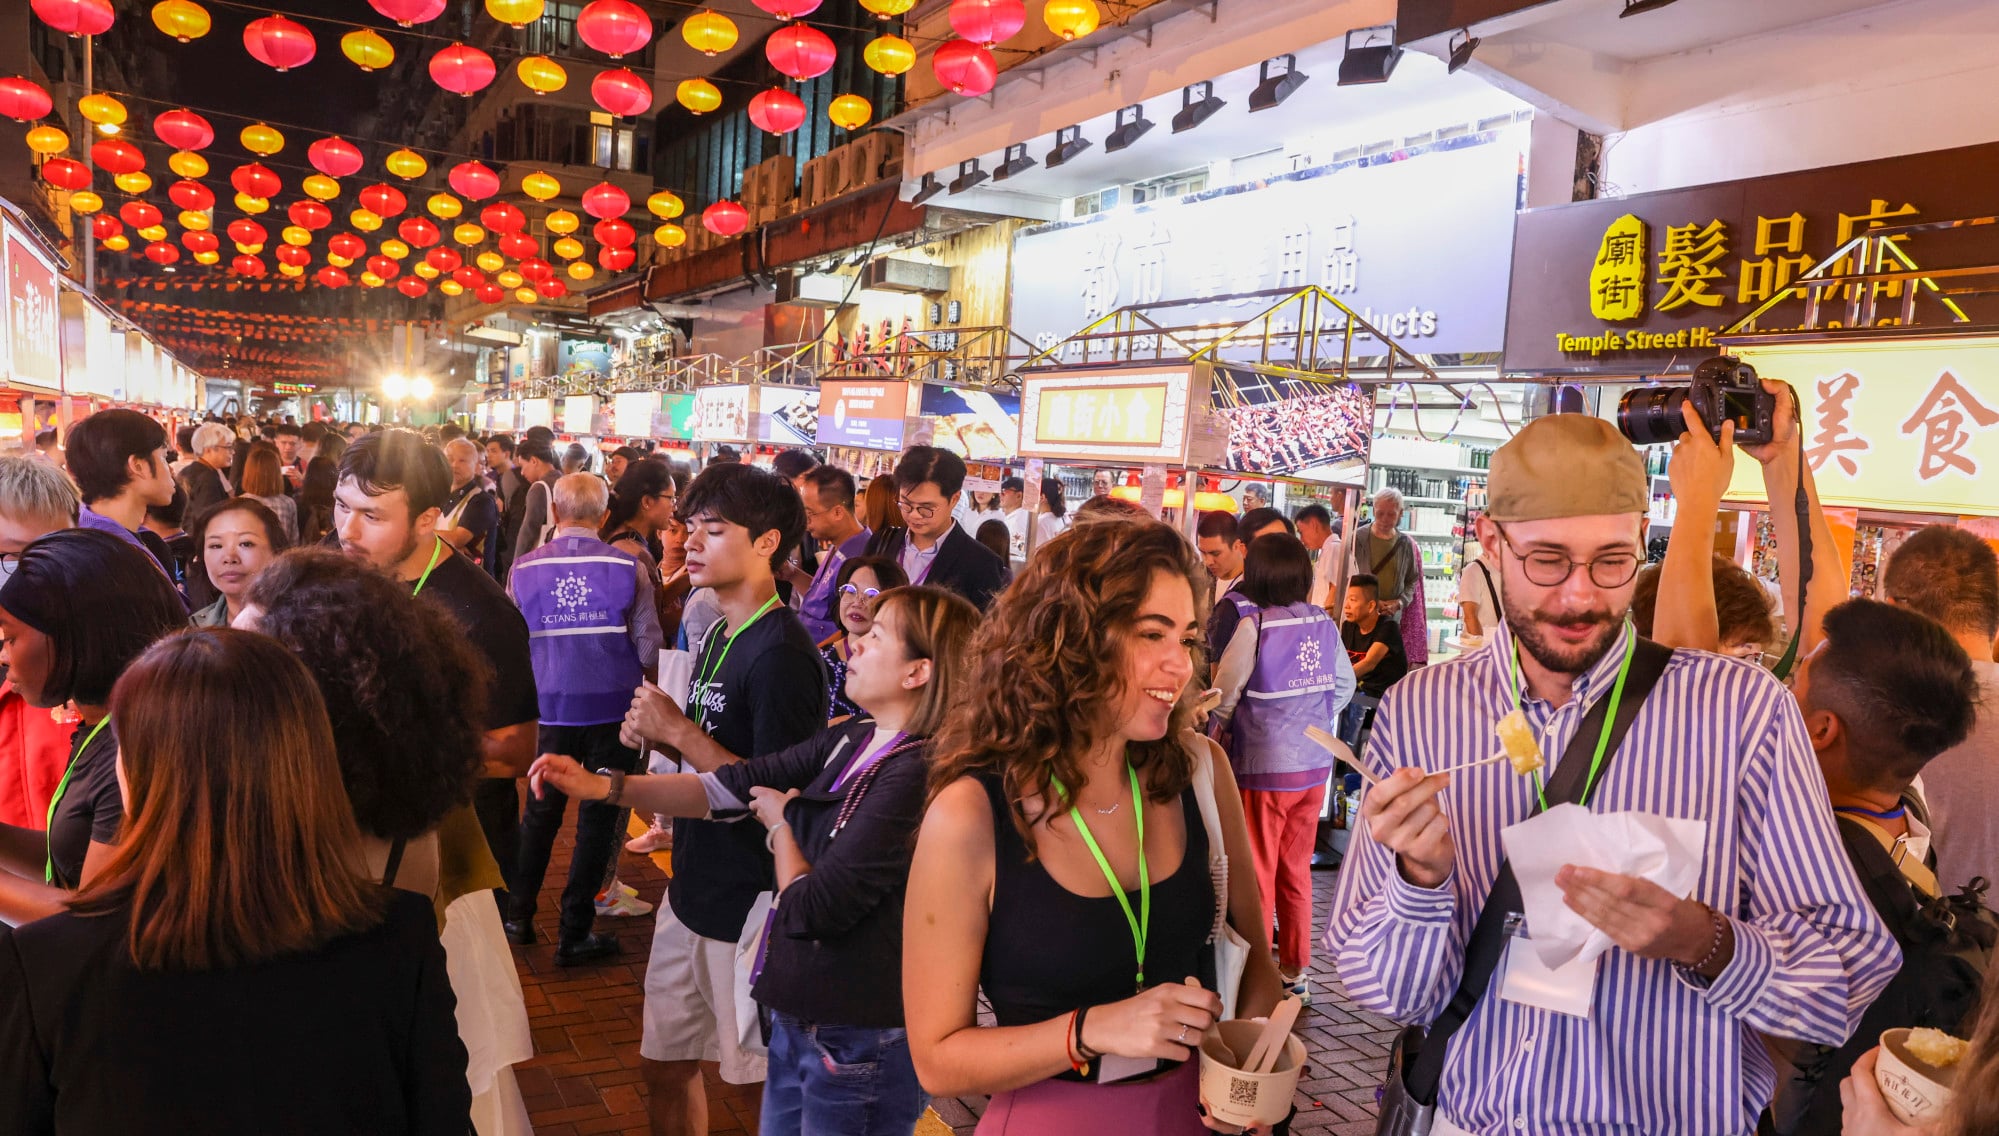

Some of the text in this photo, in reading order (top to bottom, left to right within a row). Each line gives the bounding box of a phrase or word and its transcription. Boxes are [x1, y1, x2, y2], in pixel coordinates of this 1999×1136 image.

[1081, 214, 1360, 319] 都市用品
[1598, 231, 1638, 311] 廟街
[1654, 199, 1919, 312] 髮品店
[1556, 331, 1621, 356] Temple
[1625, 327, 1688, 350] Street
[1803, 371, 1999, 481] 美食
[541, 612, 577, 624] OCTANS
[1288, 677, 1315, 688] OCTANS
